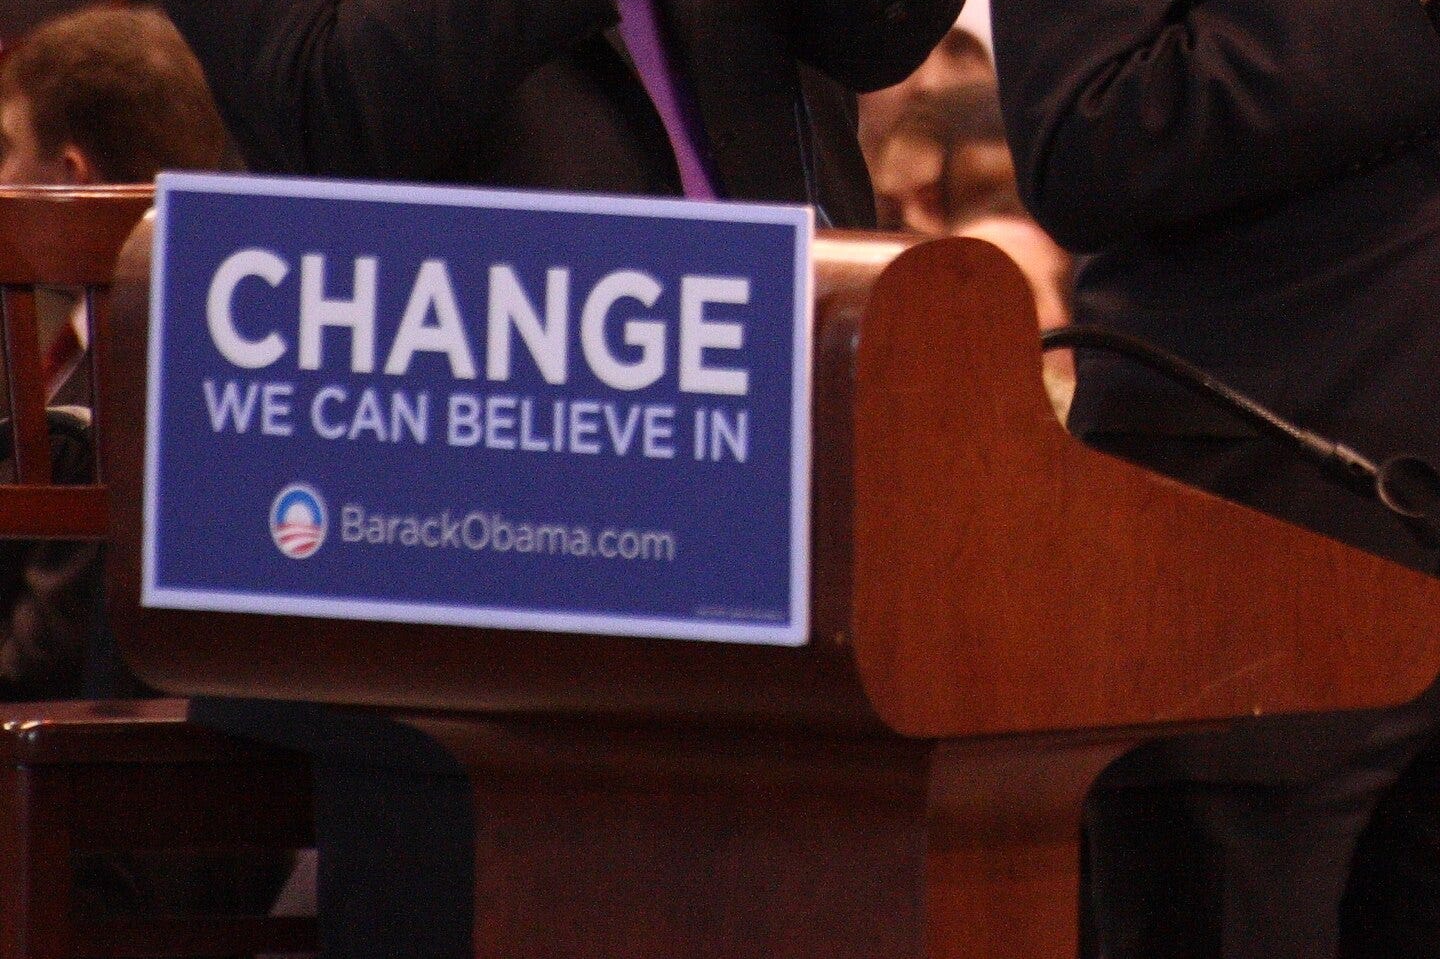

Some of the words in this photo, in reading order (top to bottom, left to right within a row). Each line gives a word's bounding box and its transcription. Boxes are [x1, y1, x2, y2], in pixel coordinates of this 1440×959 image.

[206, 247, 749, 395] CHANGE
[203, 380, 294, 436] WE
[310, 386, 428, 445] CAN
[448, 393, 676, 460] BELIEVE
[693, 407, 748, 464] IN
[341, 503, 676, 561] BarackObama.com
